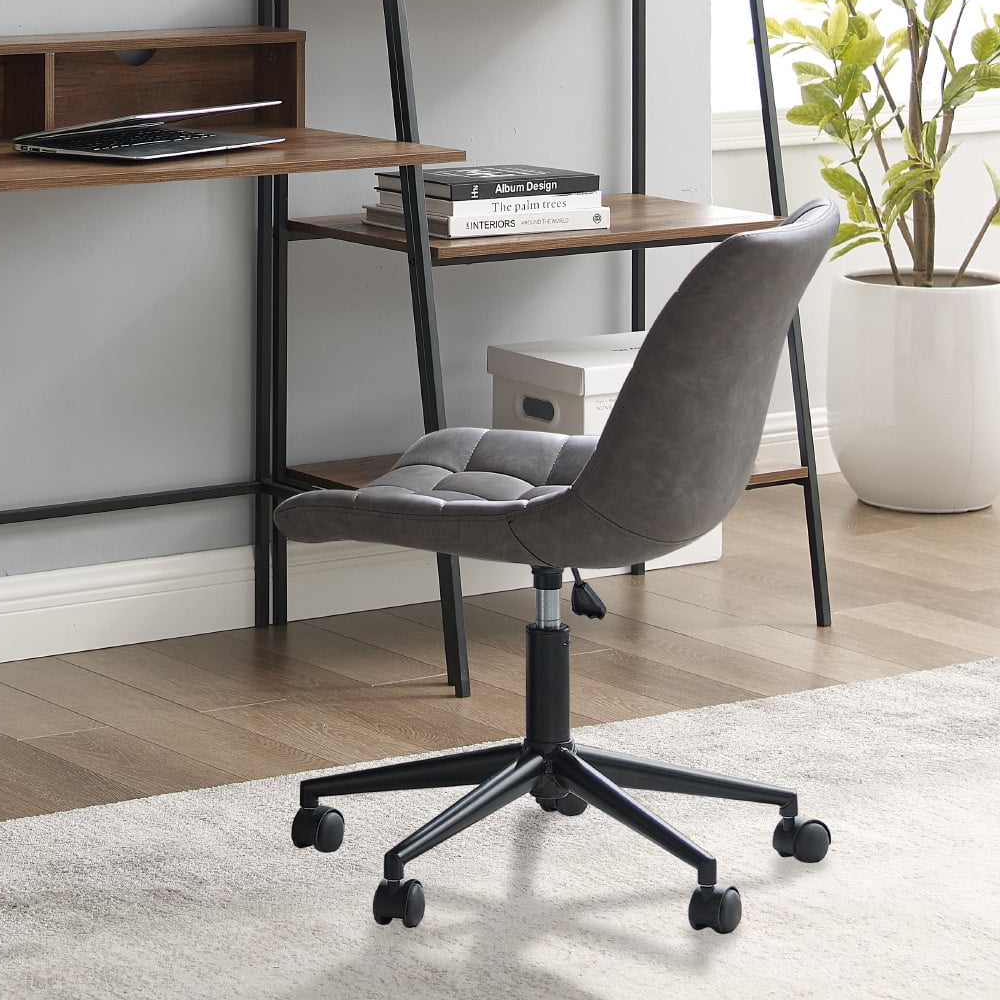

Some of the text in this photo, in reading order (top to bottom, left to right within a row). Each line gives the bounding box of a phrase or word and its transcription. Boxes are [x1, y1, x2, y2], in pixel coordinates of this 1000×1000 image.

[495, 180, 557, 194] Album Design
[491, 199, 567, 213] The palm trees
[470, 219, 516, 230] INTERIORS
